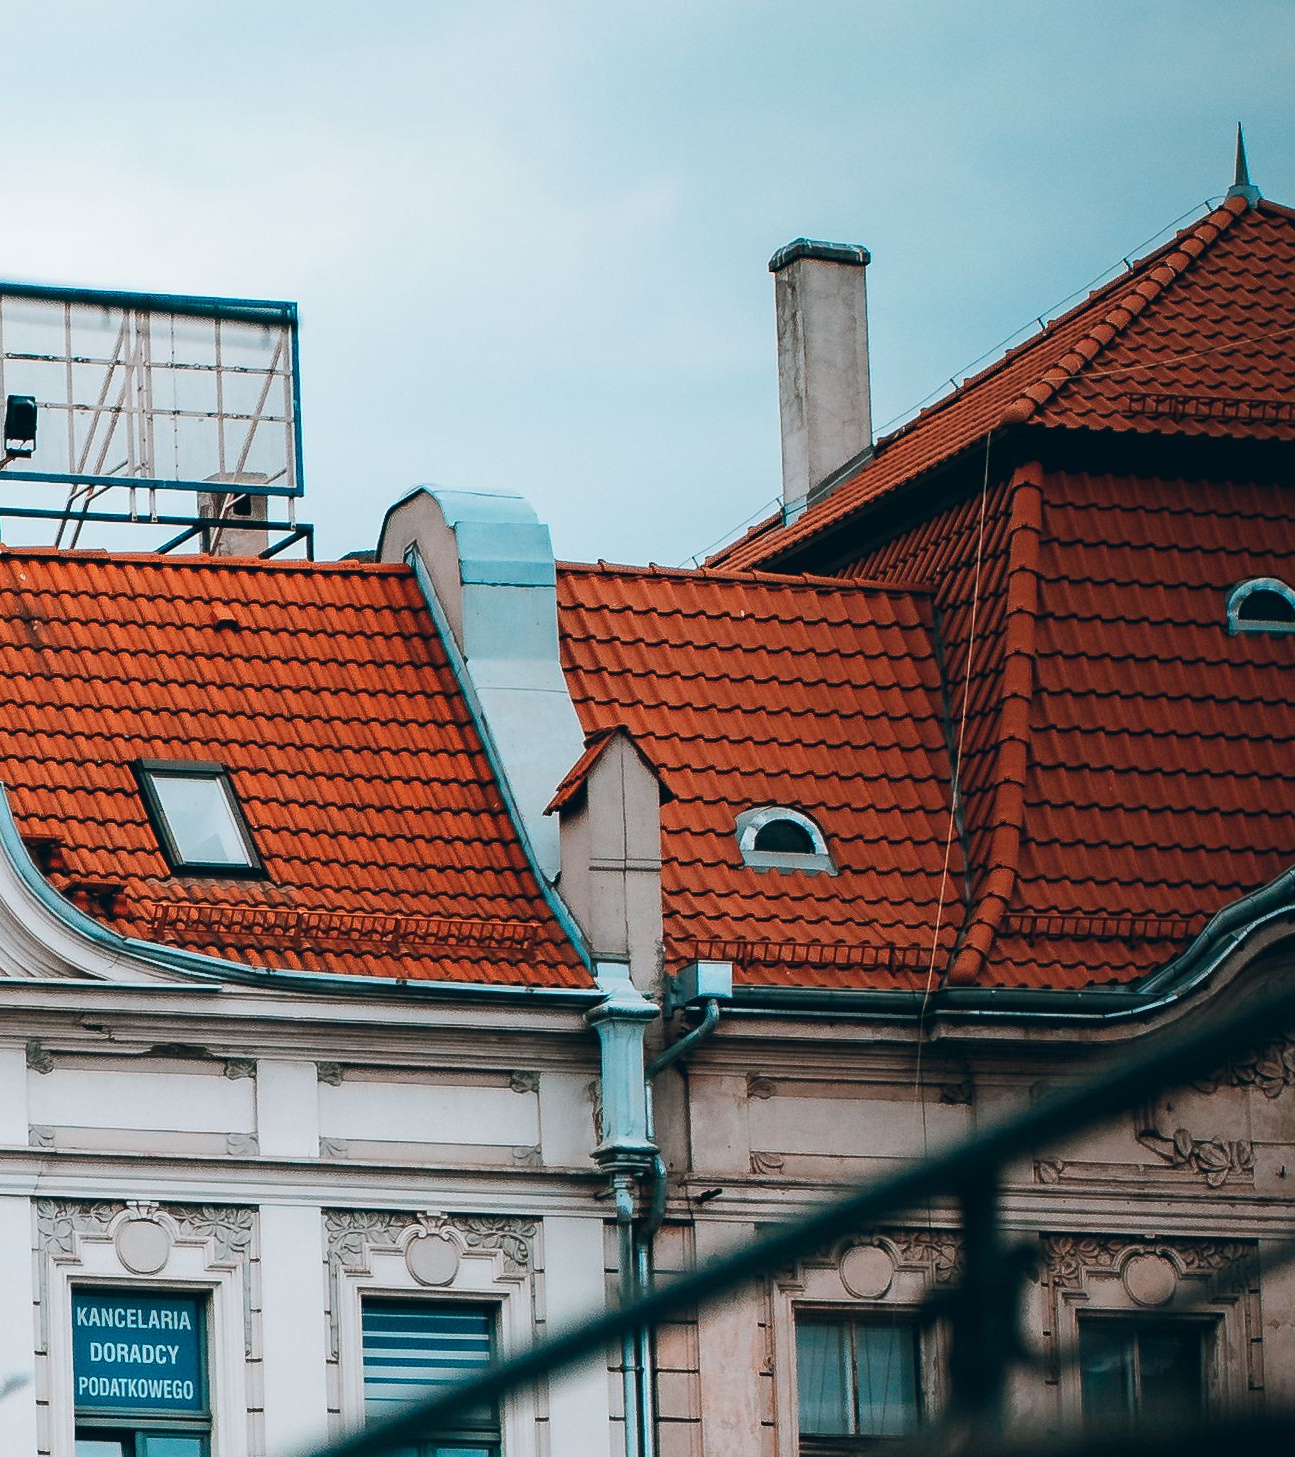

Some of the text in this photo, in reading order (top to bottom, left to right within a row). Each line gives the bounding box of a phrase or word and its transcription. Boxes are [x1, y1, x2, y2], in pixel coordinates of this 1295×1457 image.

[76, 1306, 192, 1331] KANCELARIA
[90, 1341, 180, 1365] DORADCY
[78, 1376, 194, 1400] PODATKOWEGO
